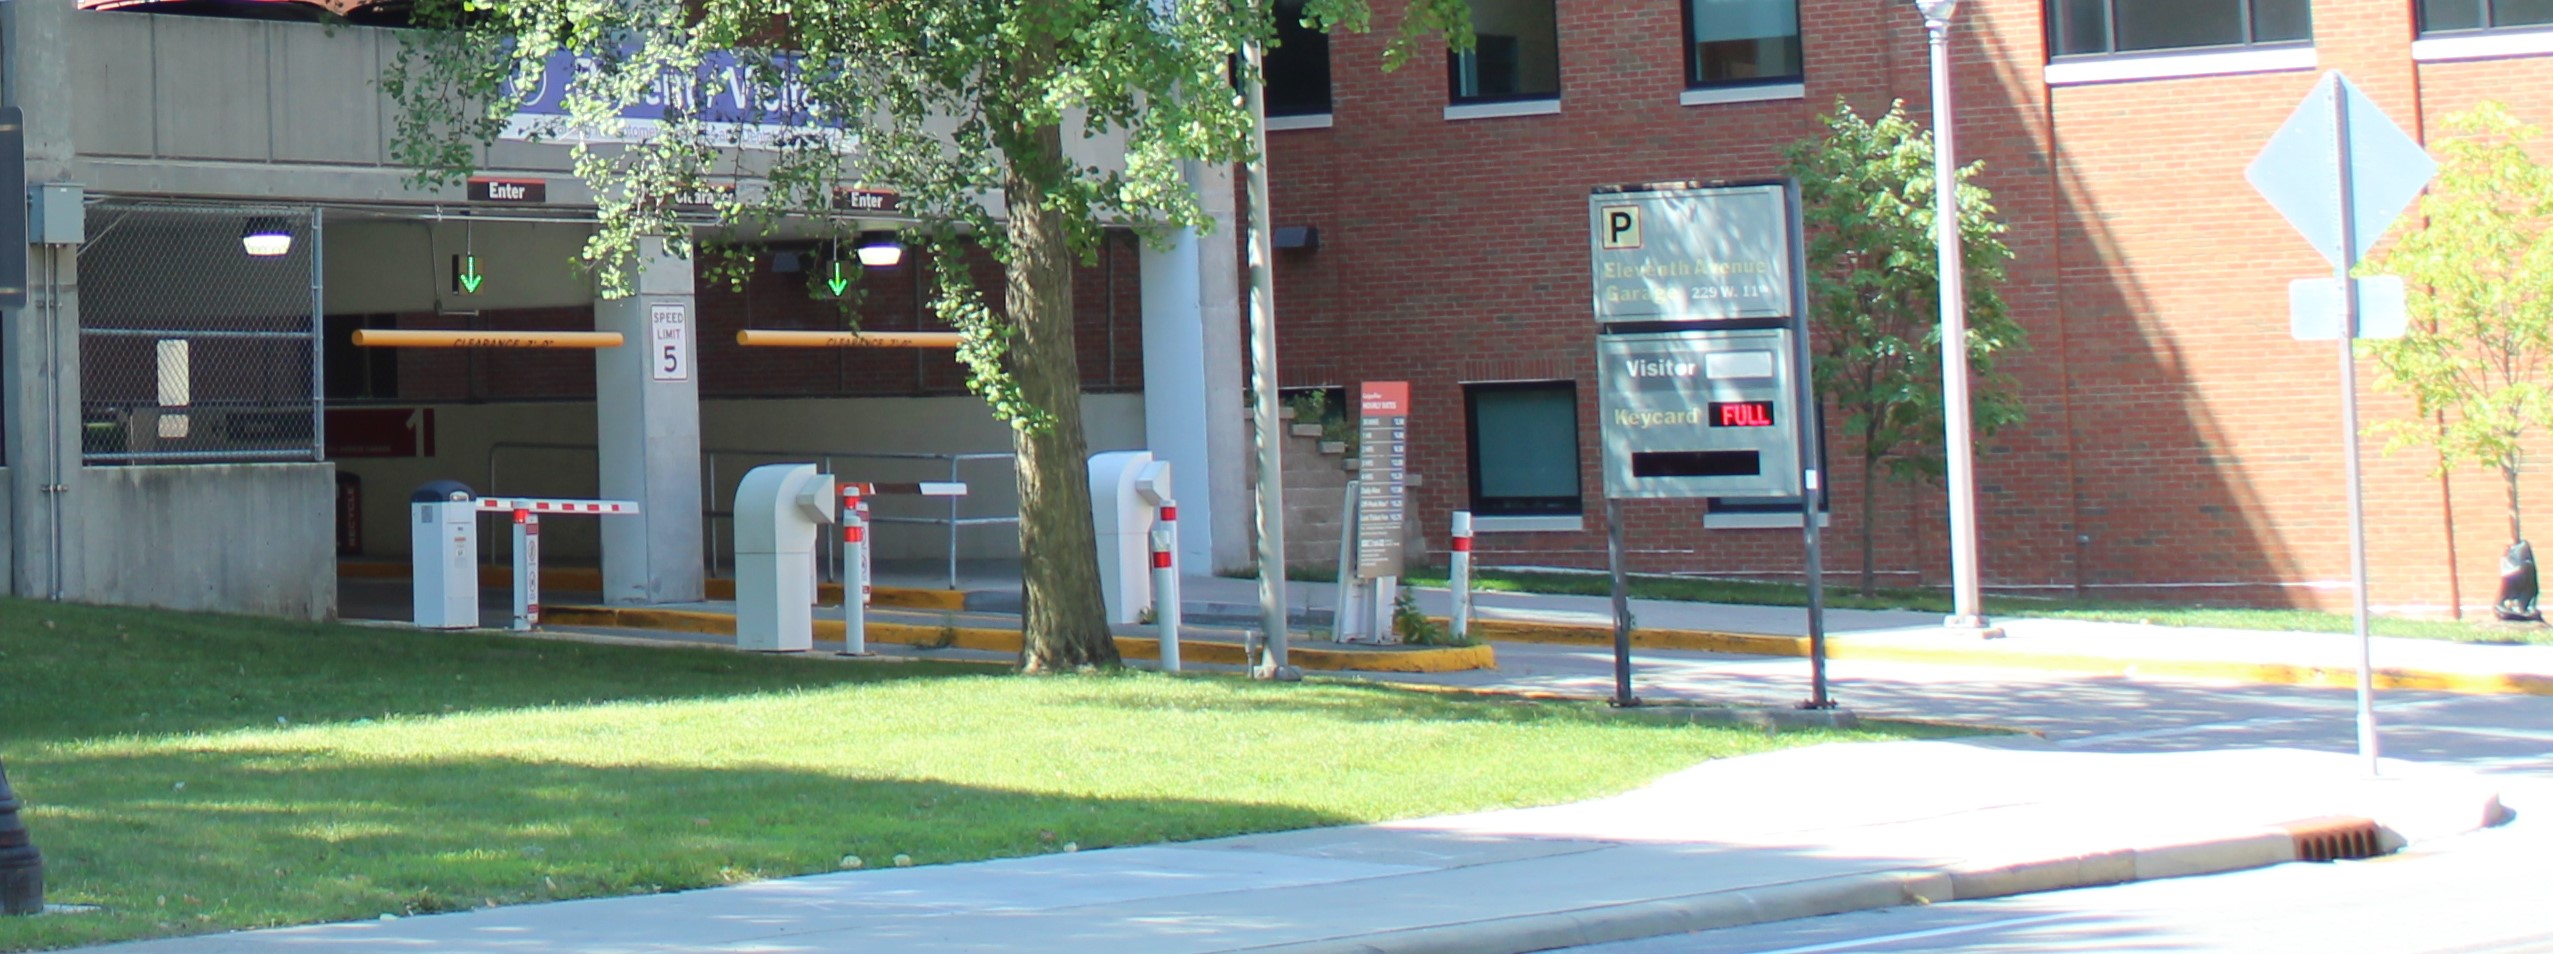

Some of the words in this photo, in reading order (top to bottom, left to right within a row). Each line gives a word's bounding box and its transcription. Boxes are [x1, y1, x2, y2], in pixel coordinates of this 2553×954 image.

[489, 181, 525, 200] Enter
[851, 191, 884, 208] Enter
[1610, 211, 1632, 243] P
[1603, 258, 1690, 279] Eleventh
[1693, 257, 1768, 276] Avenue
[1605, 284, 1681, 305] Garage
[1691, 286, 1718, 300] 229
[1719, 285, 1738, 298] W.
[653, 311, 683, 324] SPEED
[657, 328, 681, 340] LIMIT
[663, 345, 678, 373] 5
[1625, 358, 1698, 378] Visitor
[1614, 406, 1700, 430] Keycard
[1721, 403, 1771, 427] FULL
